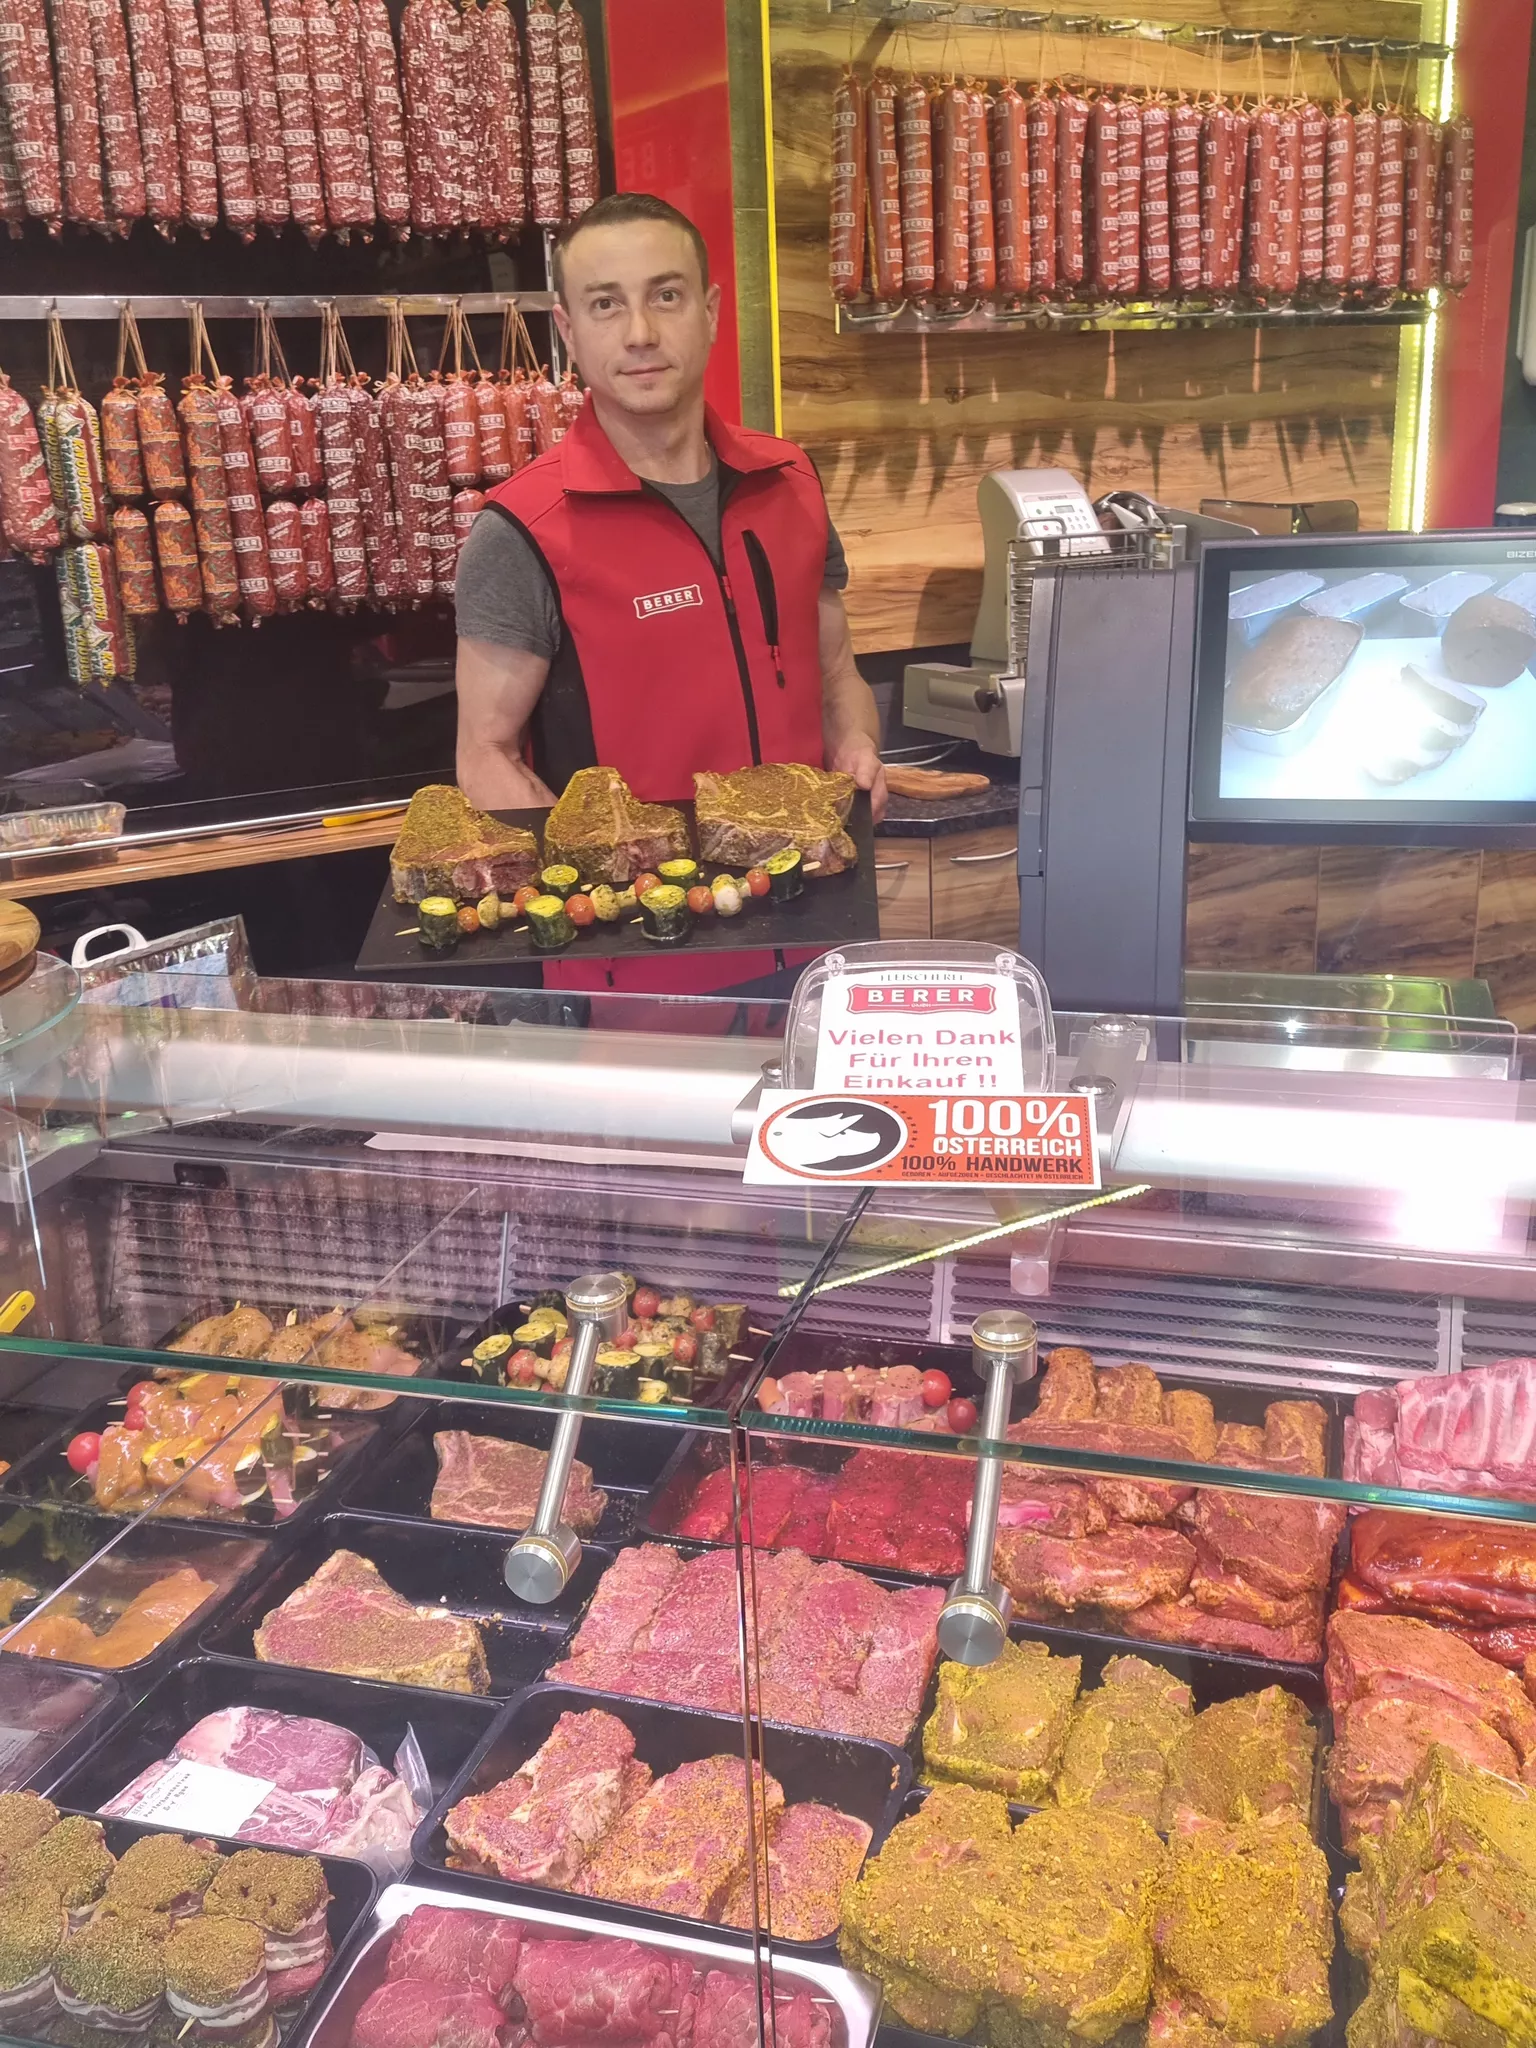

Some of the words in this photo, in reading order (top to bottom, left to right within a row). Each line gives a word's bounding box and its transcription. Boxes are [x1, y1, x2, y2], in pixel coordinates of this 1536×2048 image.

[73, 439, 96, 521] KNOBLAUCH
[1506, 550, 1536, 559] BIZE
[85, 550, 108, 621] NOBLAUCH
[643, 590, 694, 611] BERER
[867, 989, 975, 1003] BERER
[828, 1029, 923, 1045] Vielen
[936, 1029, 1015, 1045] Dank
[849, 1053, 902, 1068] Für
[913, 1052, 993, 1067] Ihren
[843, 1073, 967, 1089] Einkauf
[928, 1099, 1081, 1138] 100%
[900, 1155, 957, 1171] 100%
[966, 1156, 1083, 1173] HANDWERK
